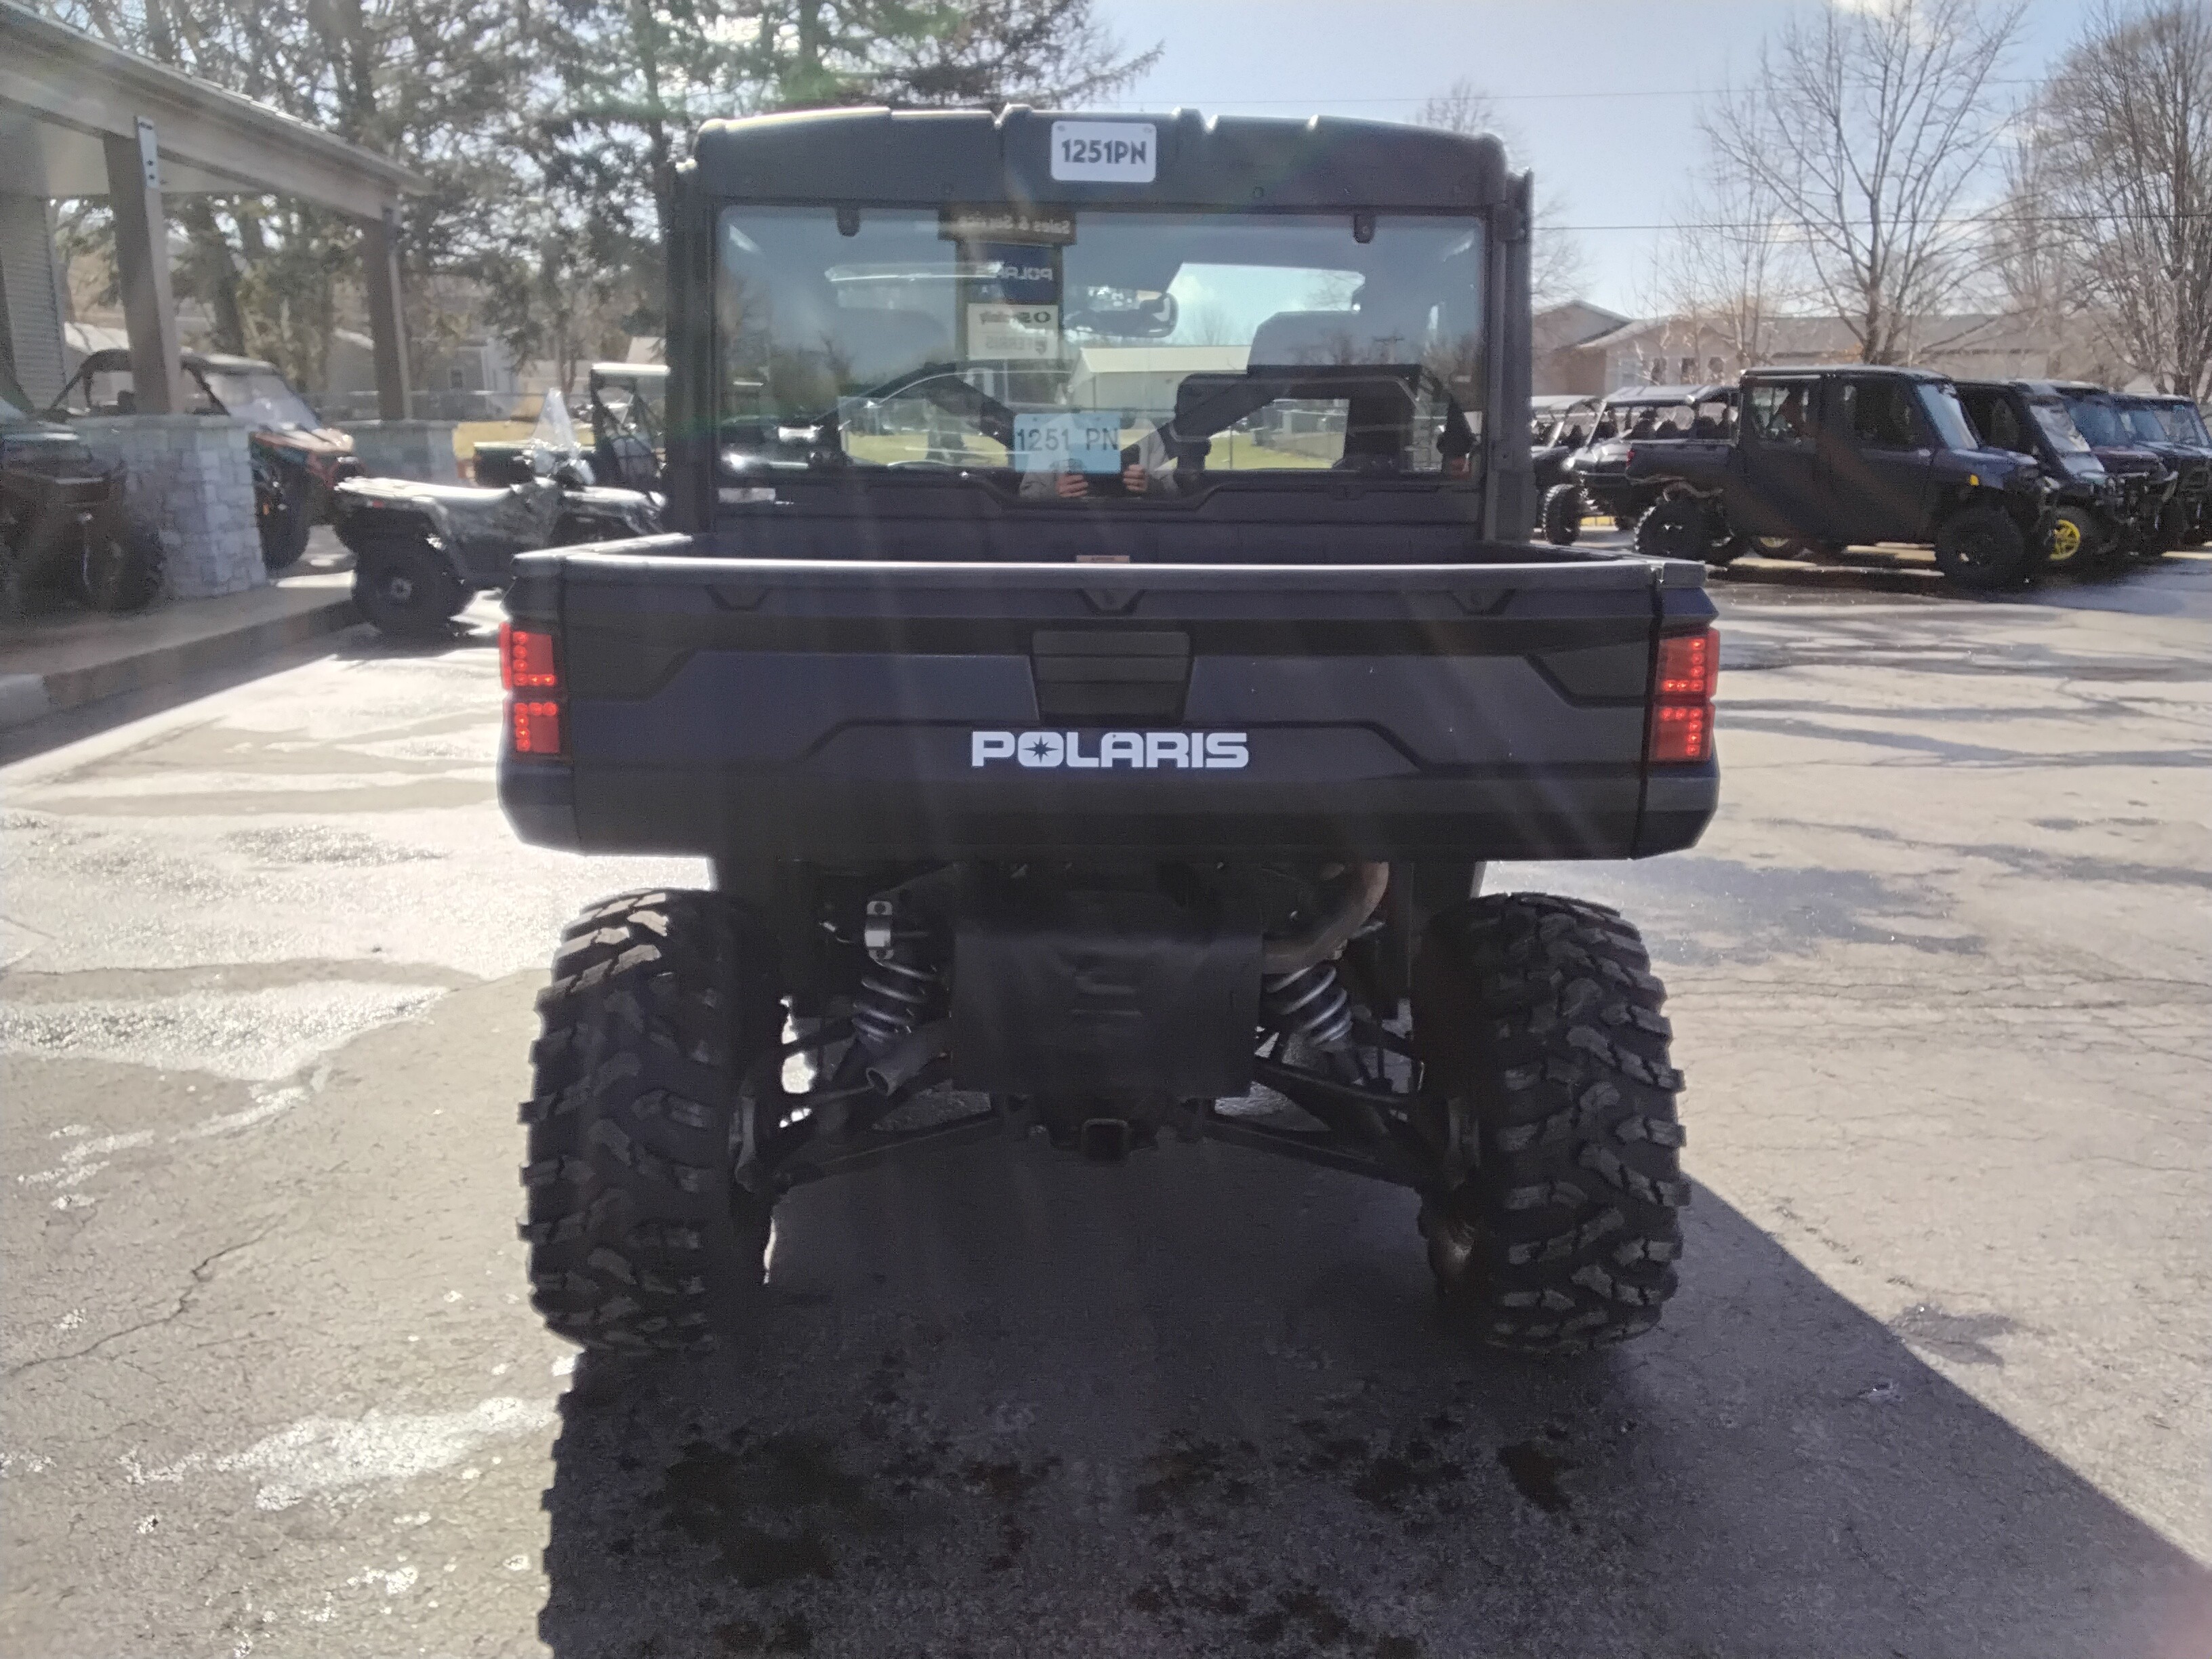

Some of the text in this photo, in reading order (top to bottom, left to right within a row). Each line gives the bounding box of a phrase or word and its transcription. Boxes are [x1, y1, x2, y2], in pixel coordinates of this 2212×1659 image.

[1061, 138, 1147, 165] 1251PN
[1017, 428, 1118, 451] 1251 PN
[972, 731, 1249, 768] POLARIS
